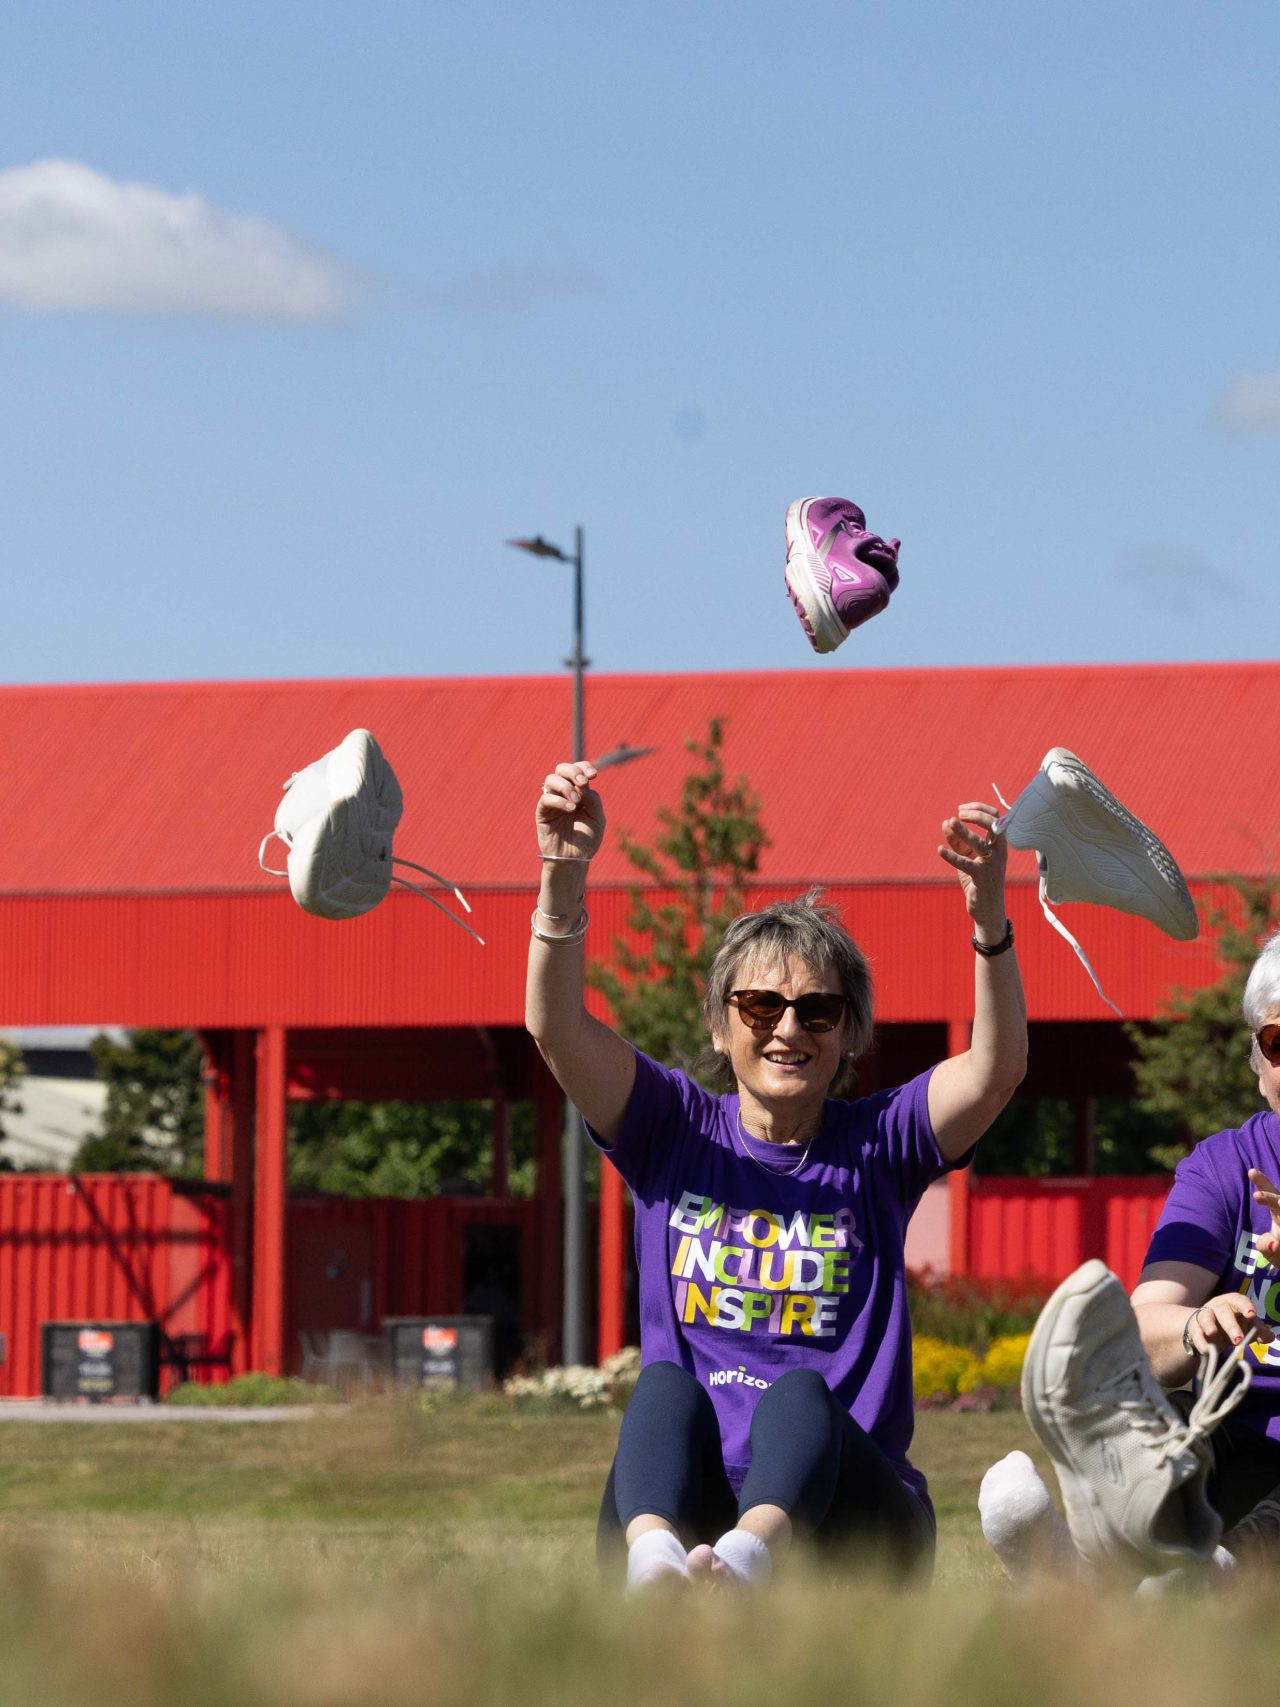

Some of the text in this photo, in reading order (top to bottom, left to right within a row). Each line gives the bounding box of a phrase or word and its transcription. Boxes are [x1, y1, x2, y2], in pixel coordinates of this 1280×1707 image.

[669, 1190, 864, 1250] EMPOWER
[671, 1237, 850, 1293] INCLUDE
[674, 1280, 840, 1337] INSPIRE
